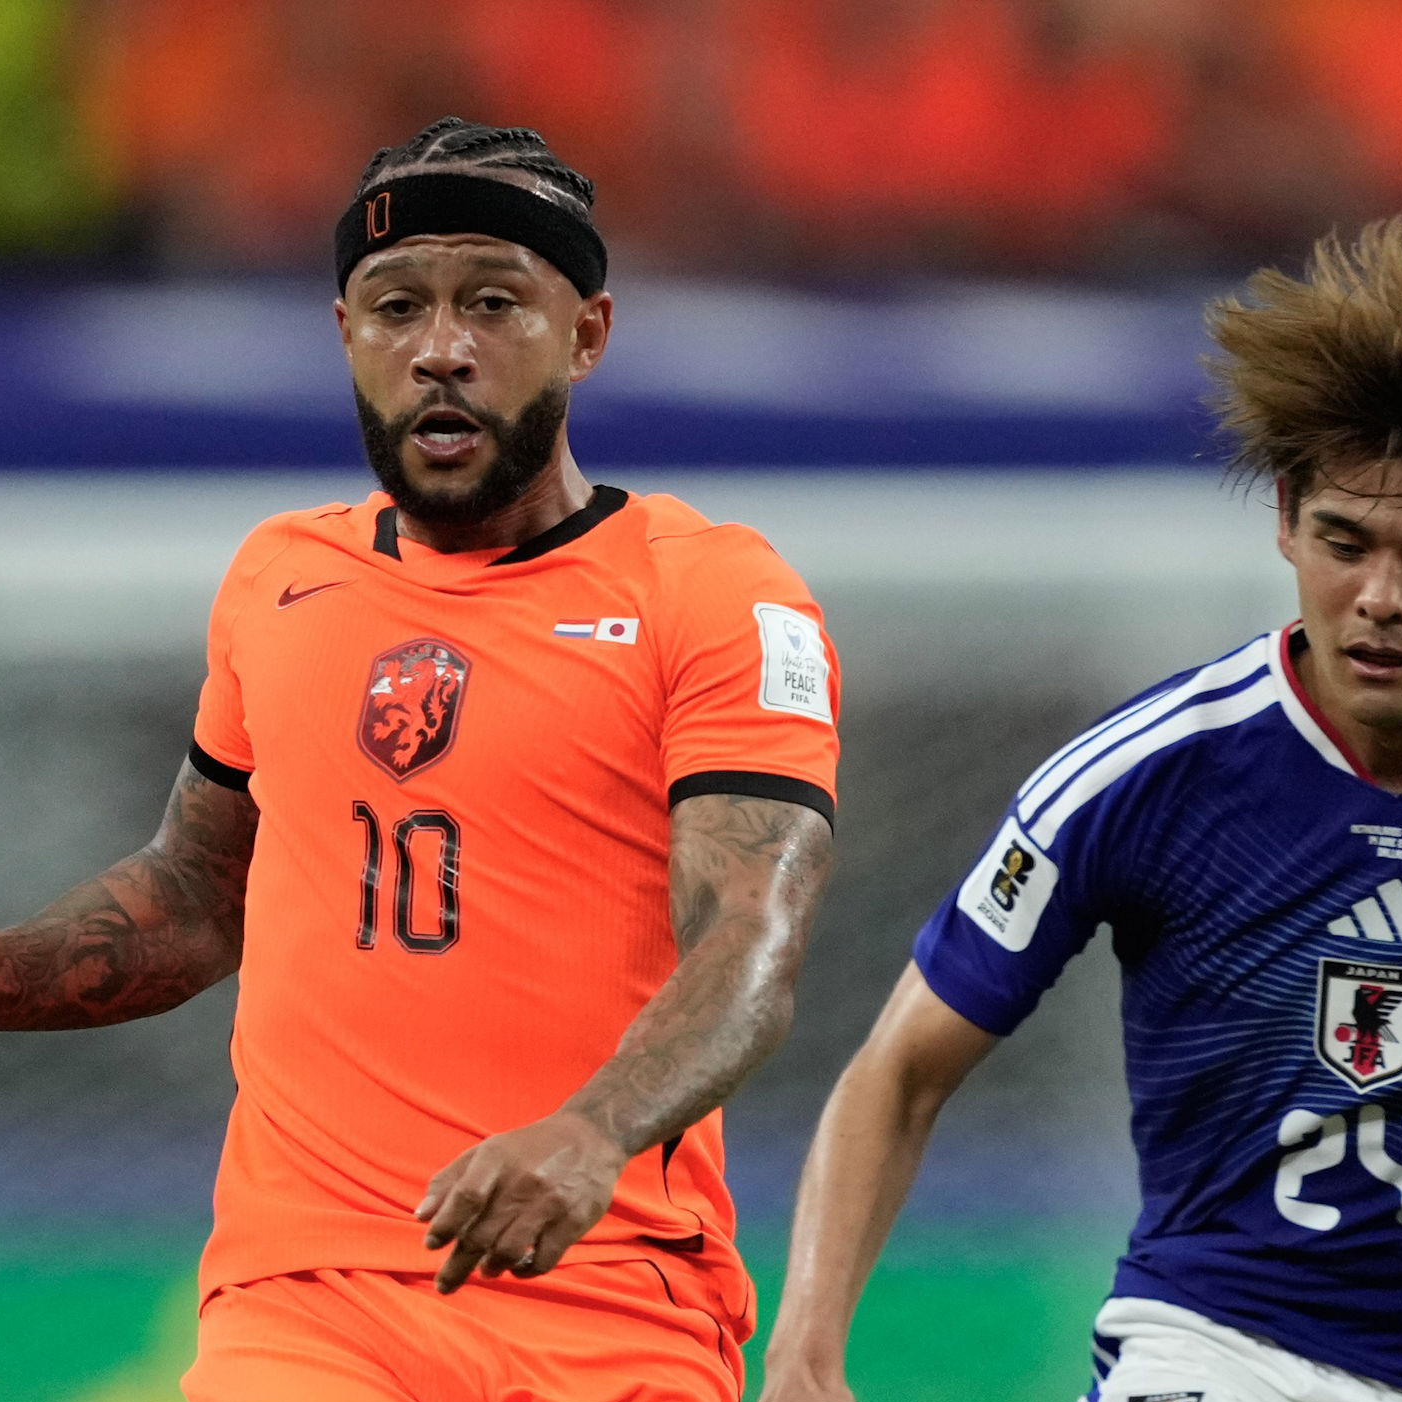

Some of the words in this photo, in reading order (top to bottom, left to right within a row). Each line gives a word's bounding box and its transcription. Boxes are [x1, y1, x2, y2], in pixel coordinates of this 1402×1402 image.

[365, 192, 390, 241] 10
[784, 670, 817, 694] PEACE
[352, 800, 461, 955] 10
[1345, 965, 1401, 981] JAPAN
[1342, 1045, 1386, 1070] JFA
